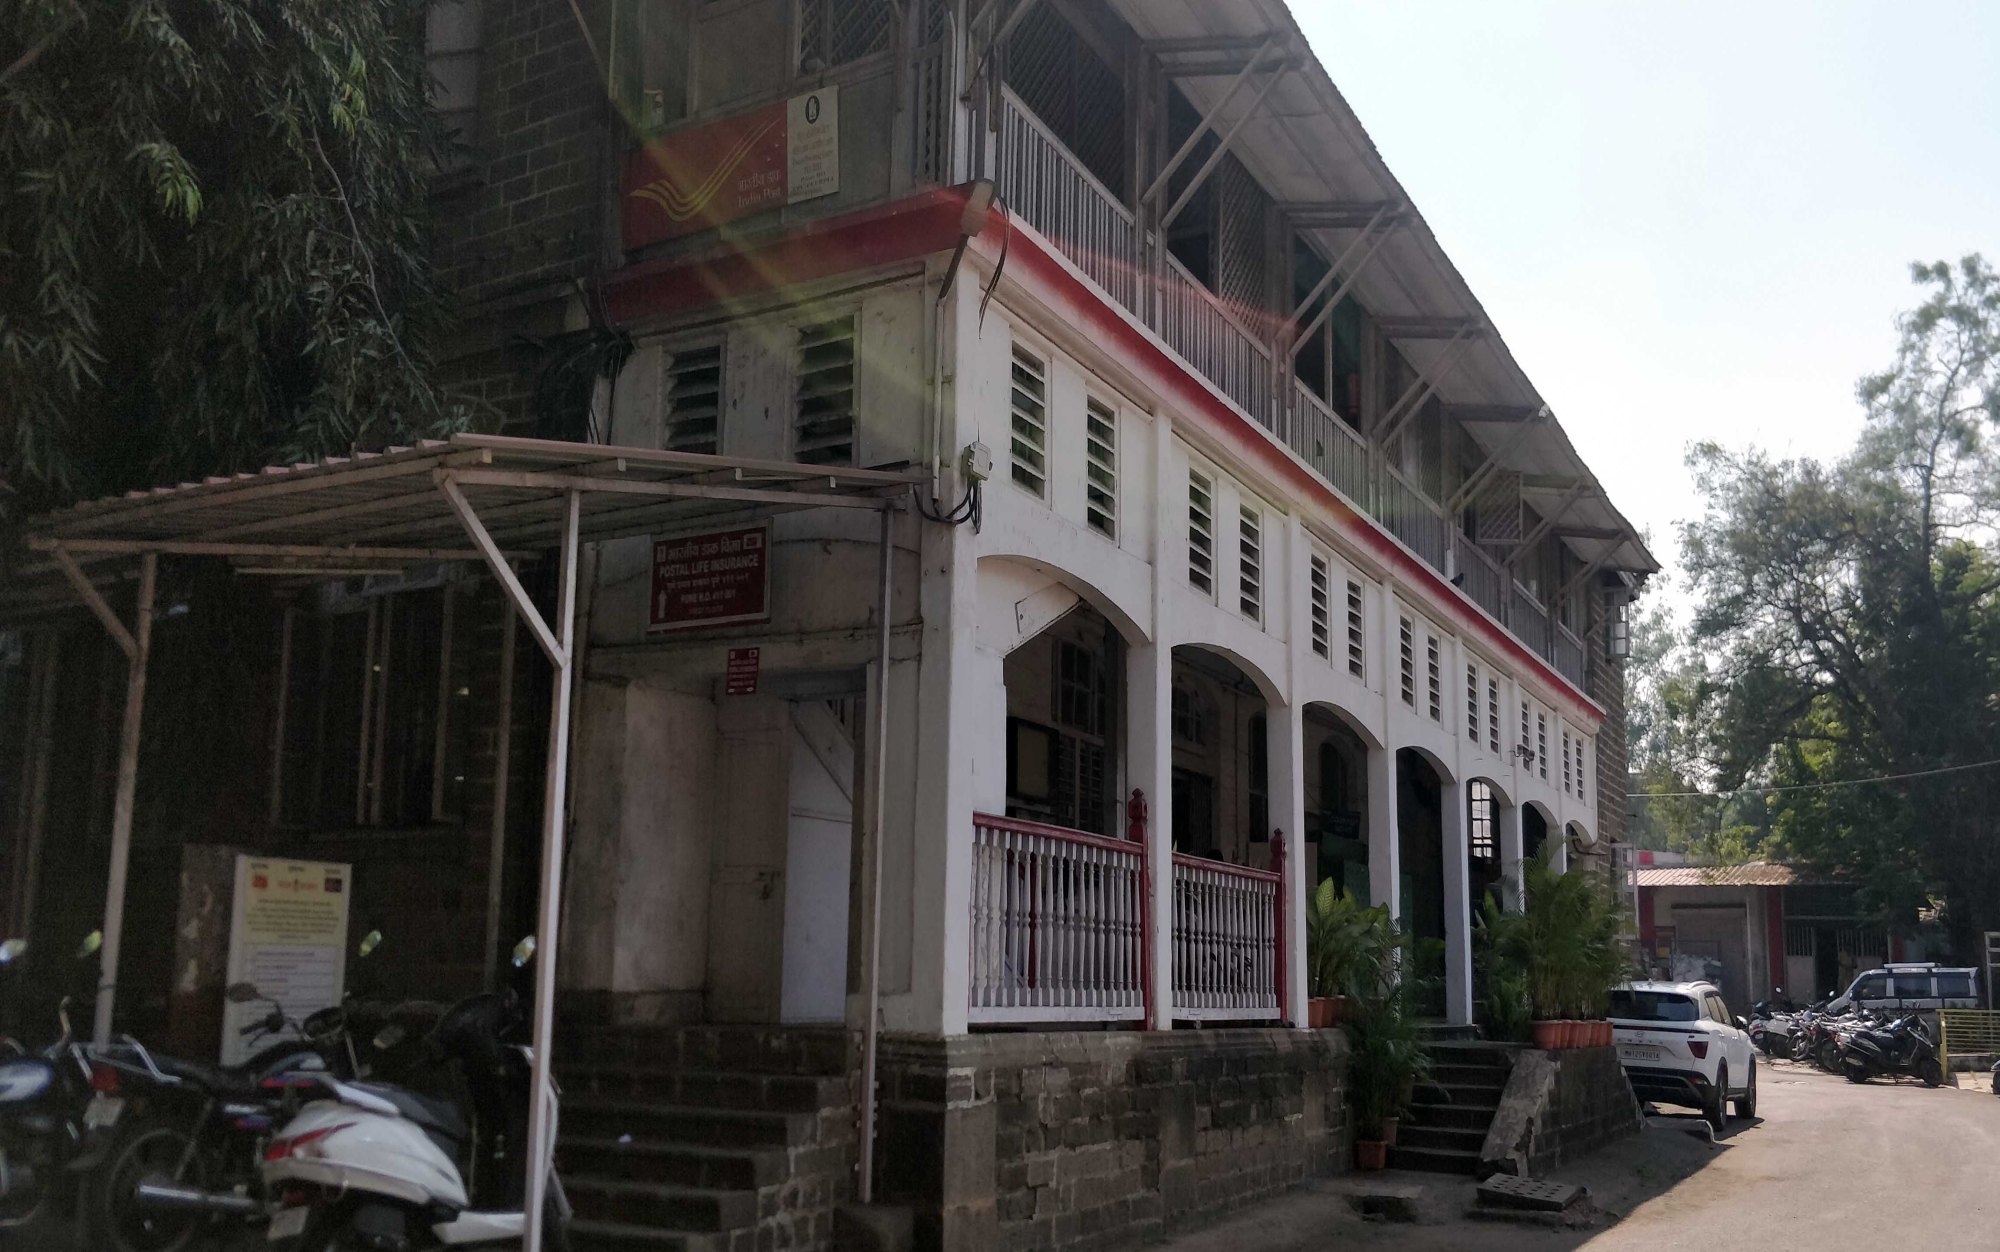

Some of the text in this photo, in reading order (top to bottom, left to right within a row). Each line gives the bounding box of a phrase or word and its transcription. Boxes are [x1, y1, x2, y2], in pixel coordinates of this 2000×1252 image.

[659, 553, 759, 578] POSTAL LIFE INSURANCE
